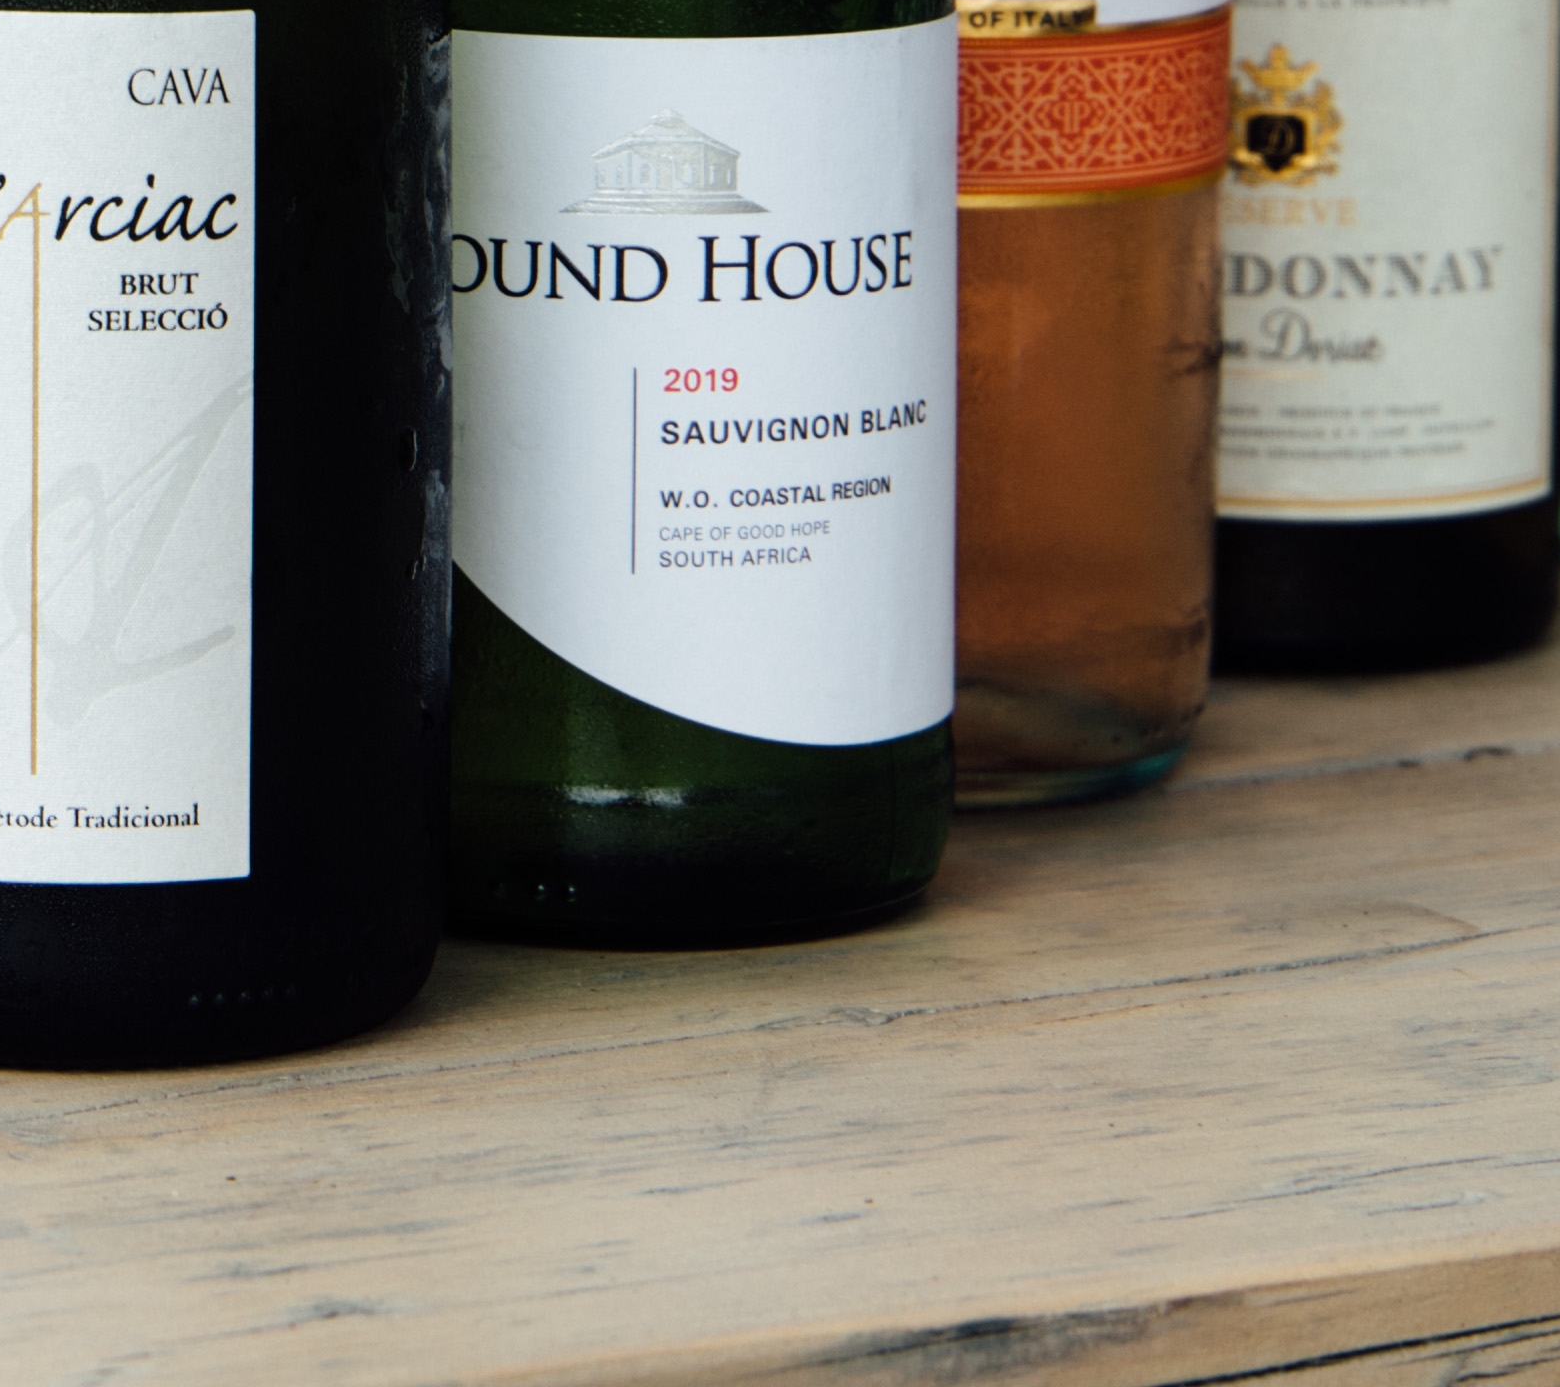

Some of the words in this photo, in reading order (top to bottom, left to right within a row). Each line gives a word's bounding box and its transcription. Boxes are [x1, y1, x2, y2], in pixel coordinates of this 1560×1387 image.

[969, 11, 1003, 28] OF
[1015, 8, 1088, 28] ITALY
[127, 67, 232, 107] CAVA
[451, 233, 669, 303] OUND
[1224, 243, 1505, 300] DONNAY
[120, 271, 199, 297] BRUT
[87, 301, 228, 333] SELECCIÓ
[663, 367, 740, 394] 2019
[660, 411, 850, 447] SAUVIGNON
[860, 398, 928, 436] BLANC
[660, 489, 719, 510] W.O.
[729, 483, 827, 509] COASTAL
[831, 475, 893, 503] REGION
[658, 524, 703, 543] CAPE
[707, 524, 731, 542] OF
[736, 522, 786, 541] GOOD
[790, 518, 832, 539] HOPE
[658, 548, 735, 570] SOUTH
[740, 545, 813, 568] AFRICA
[67, 803, 201, 830] Tradicional
